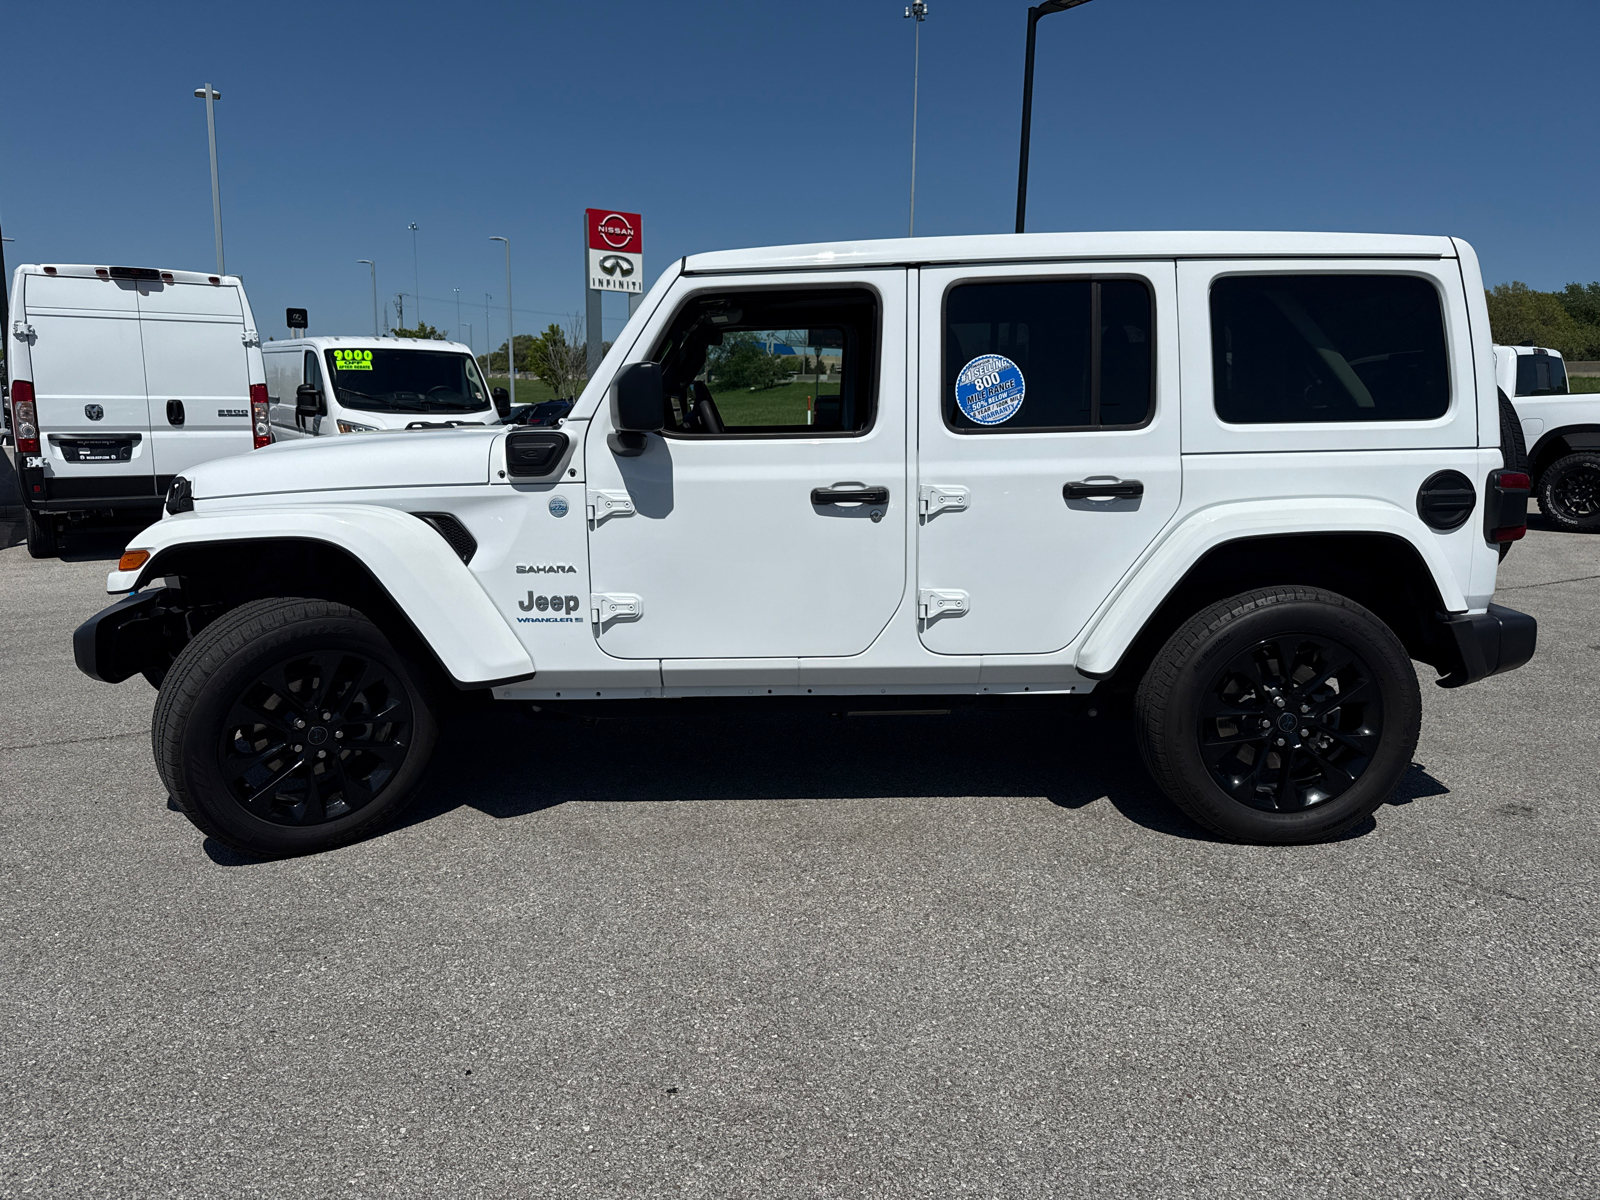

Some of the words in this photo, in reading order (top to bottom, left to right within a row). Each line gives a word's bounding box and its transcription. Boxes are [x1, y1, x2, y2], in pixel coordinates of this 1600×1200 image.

[598, 225, 634, 236] NISSAN
[592, 277, 642, 291] INFINITI
[334, 350, 373, 361] 9000
[974, 358, 1007, 378] SELLING
[974, 372, 1001, 391] 800
[966, 391, 987, 405] MILE
[988, 379, 1015, 397] RANGE
[972, 400, 988, 411] 50%
[988, 392, 1008, 404] BELOW
[978, 406, 990, 415] YEAR
[980, 403, 1016, 420] WARRANTY
[516, 565, 577, 574] SAHARA
[518, 590, 580, 615] Jeep
